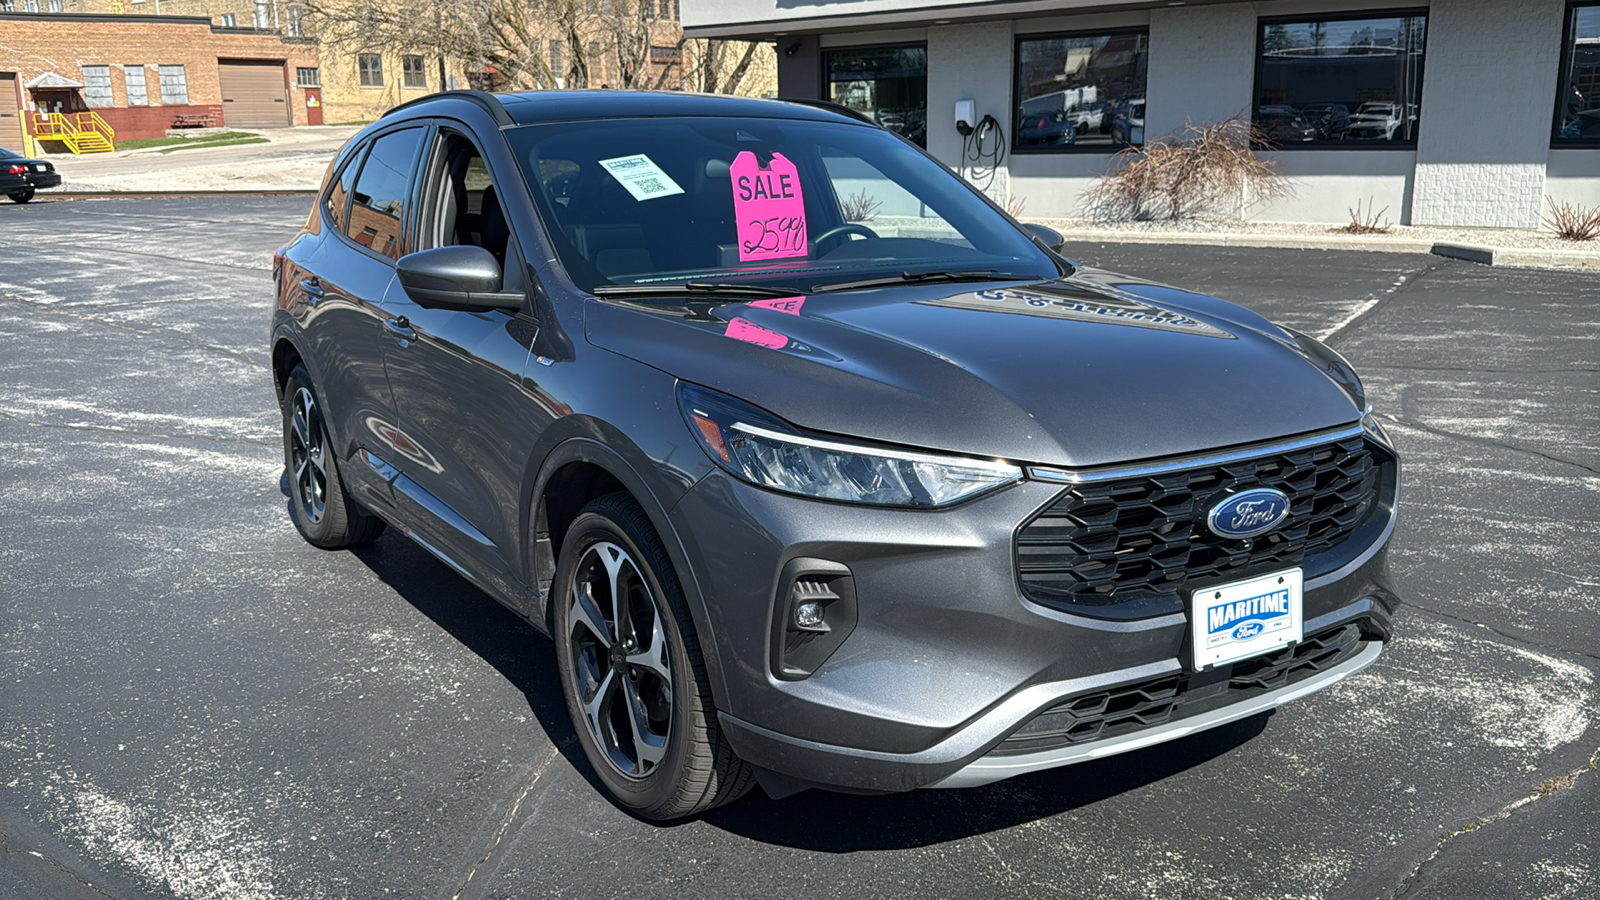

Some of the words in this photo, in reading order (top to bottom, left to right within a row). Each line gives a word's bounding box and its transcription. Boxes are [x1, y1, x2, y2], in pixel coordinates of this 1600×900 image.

[738, 174, 795, 202] SALE
[1231, 499, 1275, 529] Ford
[1209, 590, 1288, 633] MARITIME
[1236, 624, 1260, 639] Ford
